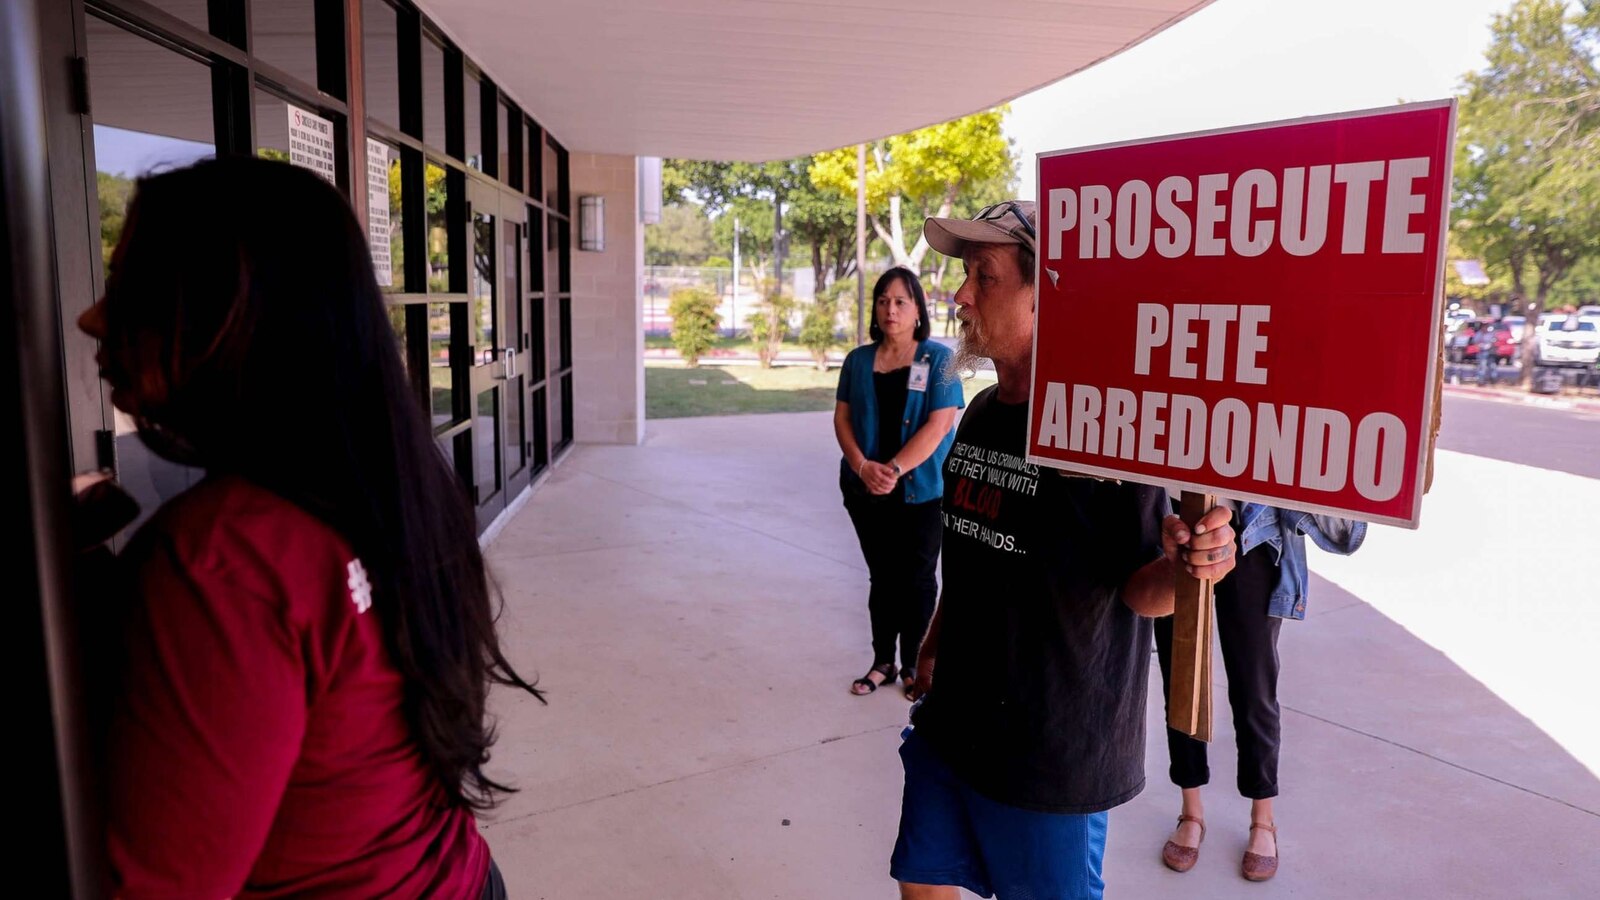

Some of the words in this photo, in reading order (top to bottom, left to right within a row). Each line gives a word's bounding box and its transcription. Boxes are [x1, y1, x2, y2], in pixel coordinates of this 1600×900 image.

[1048, 156, 1430, 260] PROSECUTE
[1134, 303, 1271, 385] PETE
[967, 445, 986, 462] CALL
[987, 450, 999, 465] US
[998, 453, 1040, 478] CRIMINALS,
[1037, 381, 1407, 502] ARREDONDO
[947, 457, 962, 473] YET
[960, 460, 988, 480] THEY
[987, 467, 1009, 488] WALK
[1007, 472, 1039, 497] WITH
[979, 525, 1027, 555] HANDS...
